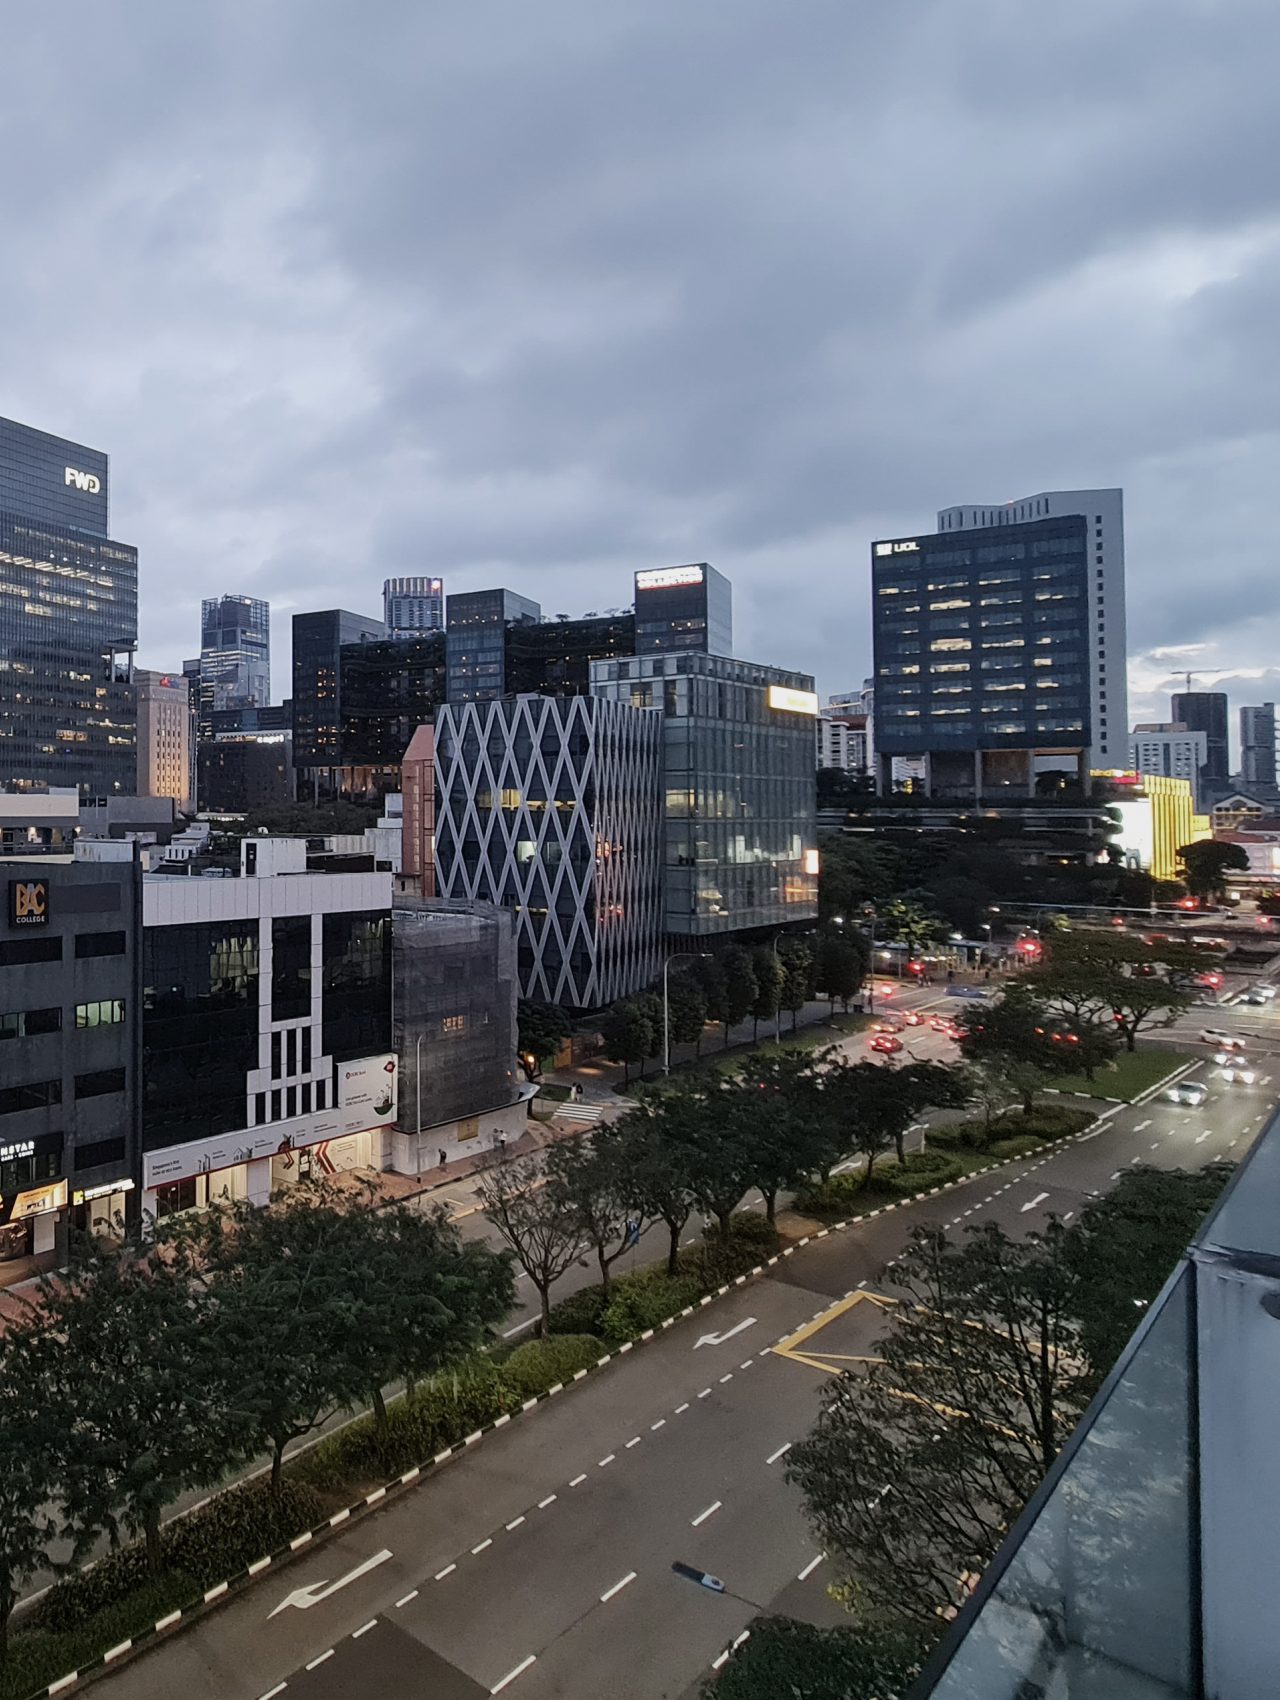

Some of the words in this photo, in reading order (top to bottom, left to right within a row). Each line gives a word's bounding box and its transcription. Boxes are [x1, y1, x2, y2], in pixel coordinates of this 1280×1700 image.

[65, 466, 101, 494] FWD
[893, 541, 921, 552] UOL
[16, 883, 45, 916] BAC
[16, 915, 45, 924] COLLEGE
